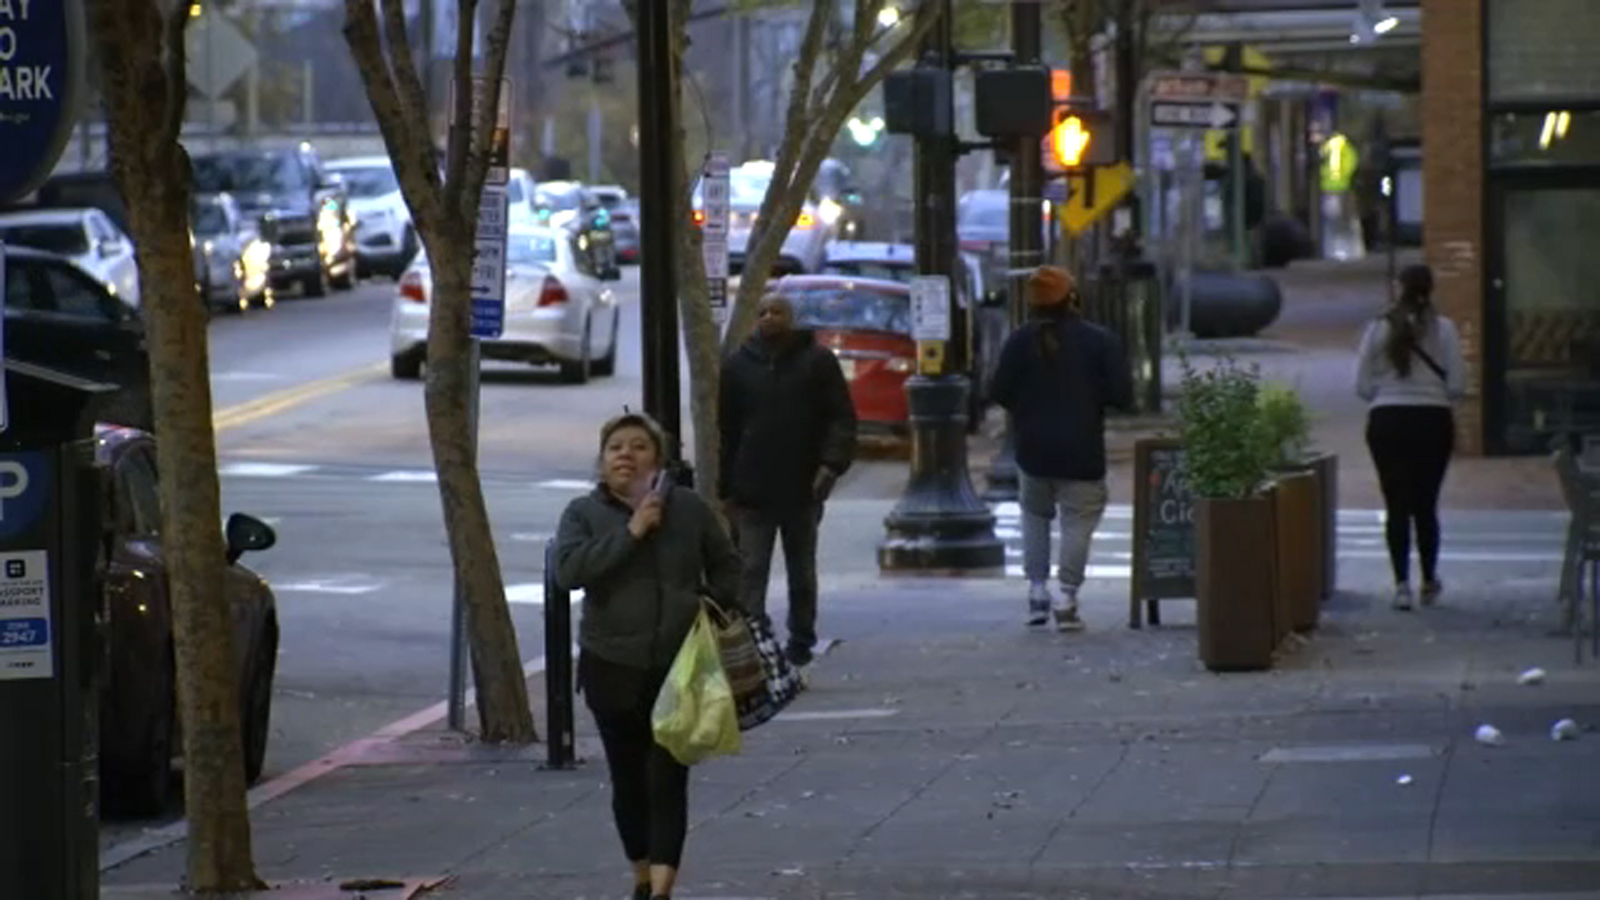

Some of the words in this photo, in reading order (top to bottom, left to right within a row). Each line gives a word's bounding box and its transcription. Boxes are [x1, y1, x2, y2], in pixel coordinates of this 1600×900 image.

[0, 0, 30, 20] AY
[0, 27, 17, 60] O
[0, 66, 53, 100] ARK
